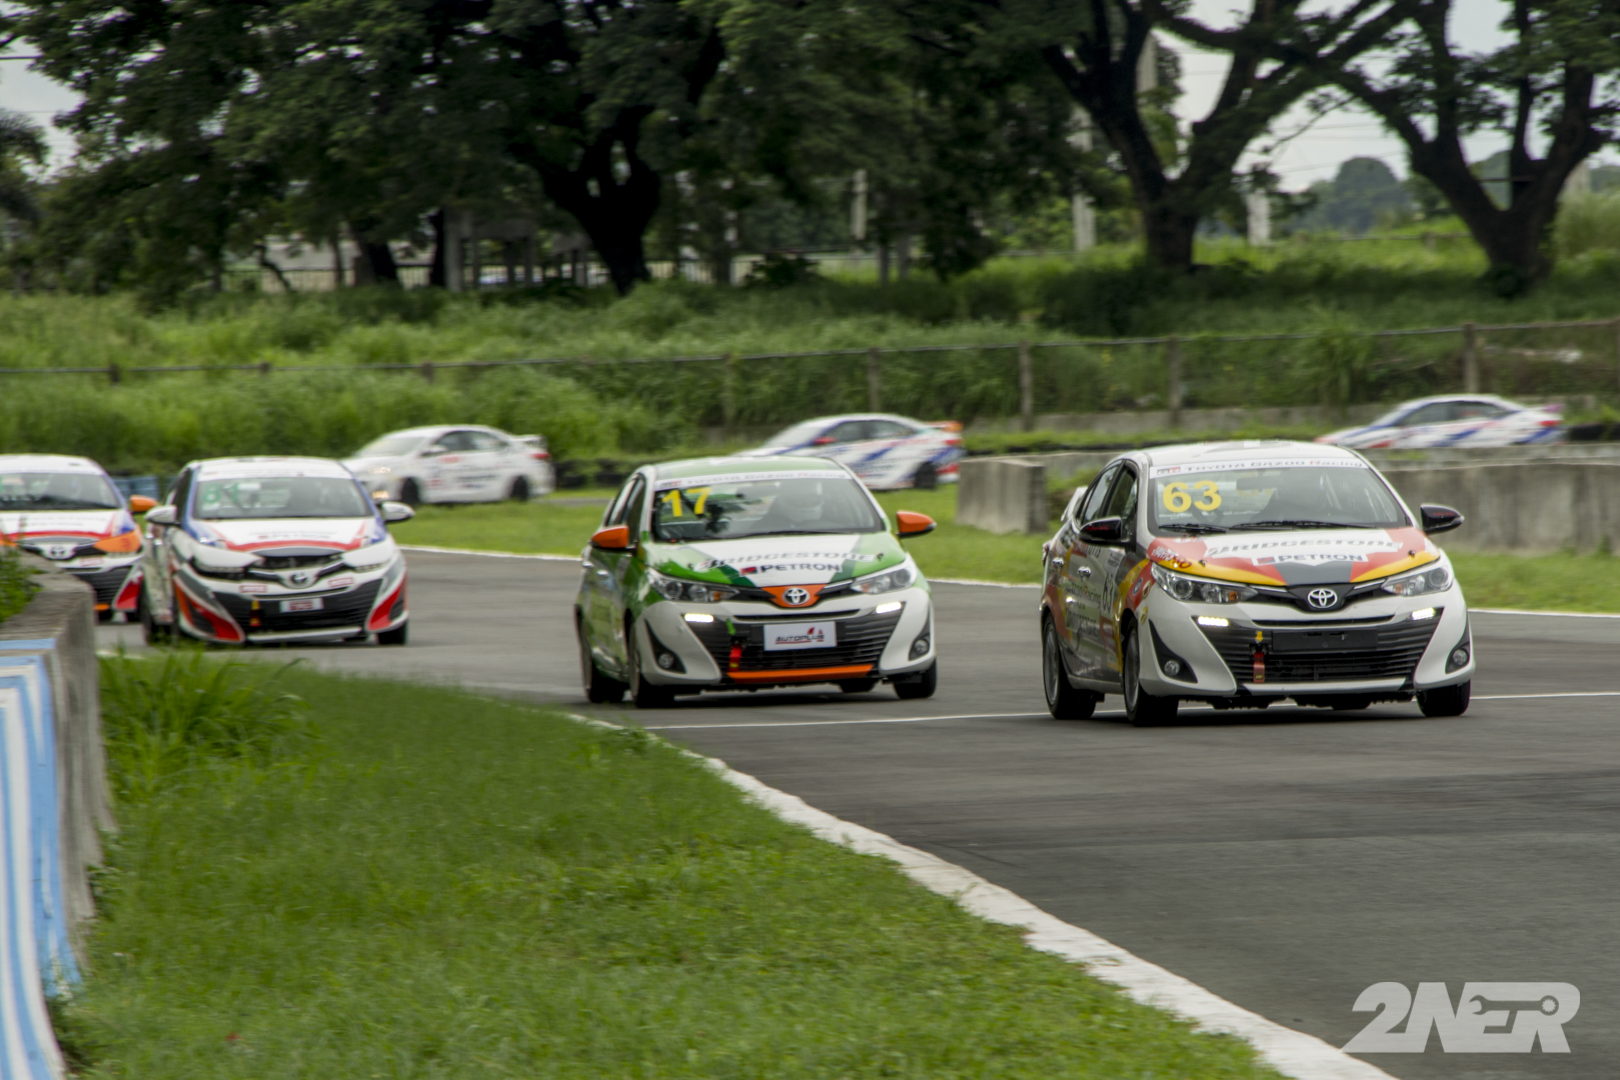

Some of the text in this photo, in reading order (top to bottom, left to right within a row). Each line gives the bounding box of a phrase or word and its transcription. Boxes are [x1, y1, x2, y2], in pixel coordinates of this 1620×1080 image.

[662, 487, 712, 517] 17
[1162, 480, 1222, 513] 63
[1205, 538, 1403, 557] BRIDGESTONE
[698, 551, 874, 568] BRIDGESTONE
[1278, 553, 1364, 563] PETRON
[760, 562, 842, 574] PETRON
[775, 634, 825, 642] AUTOPLUS
